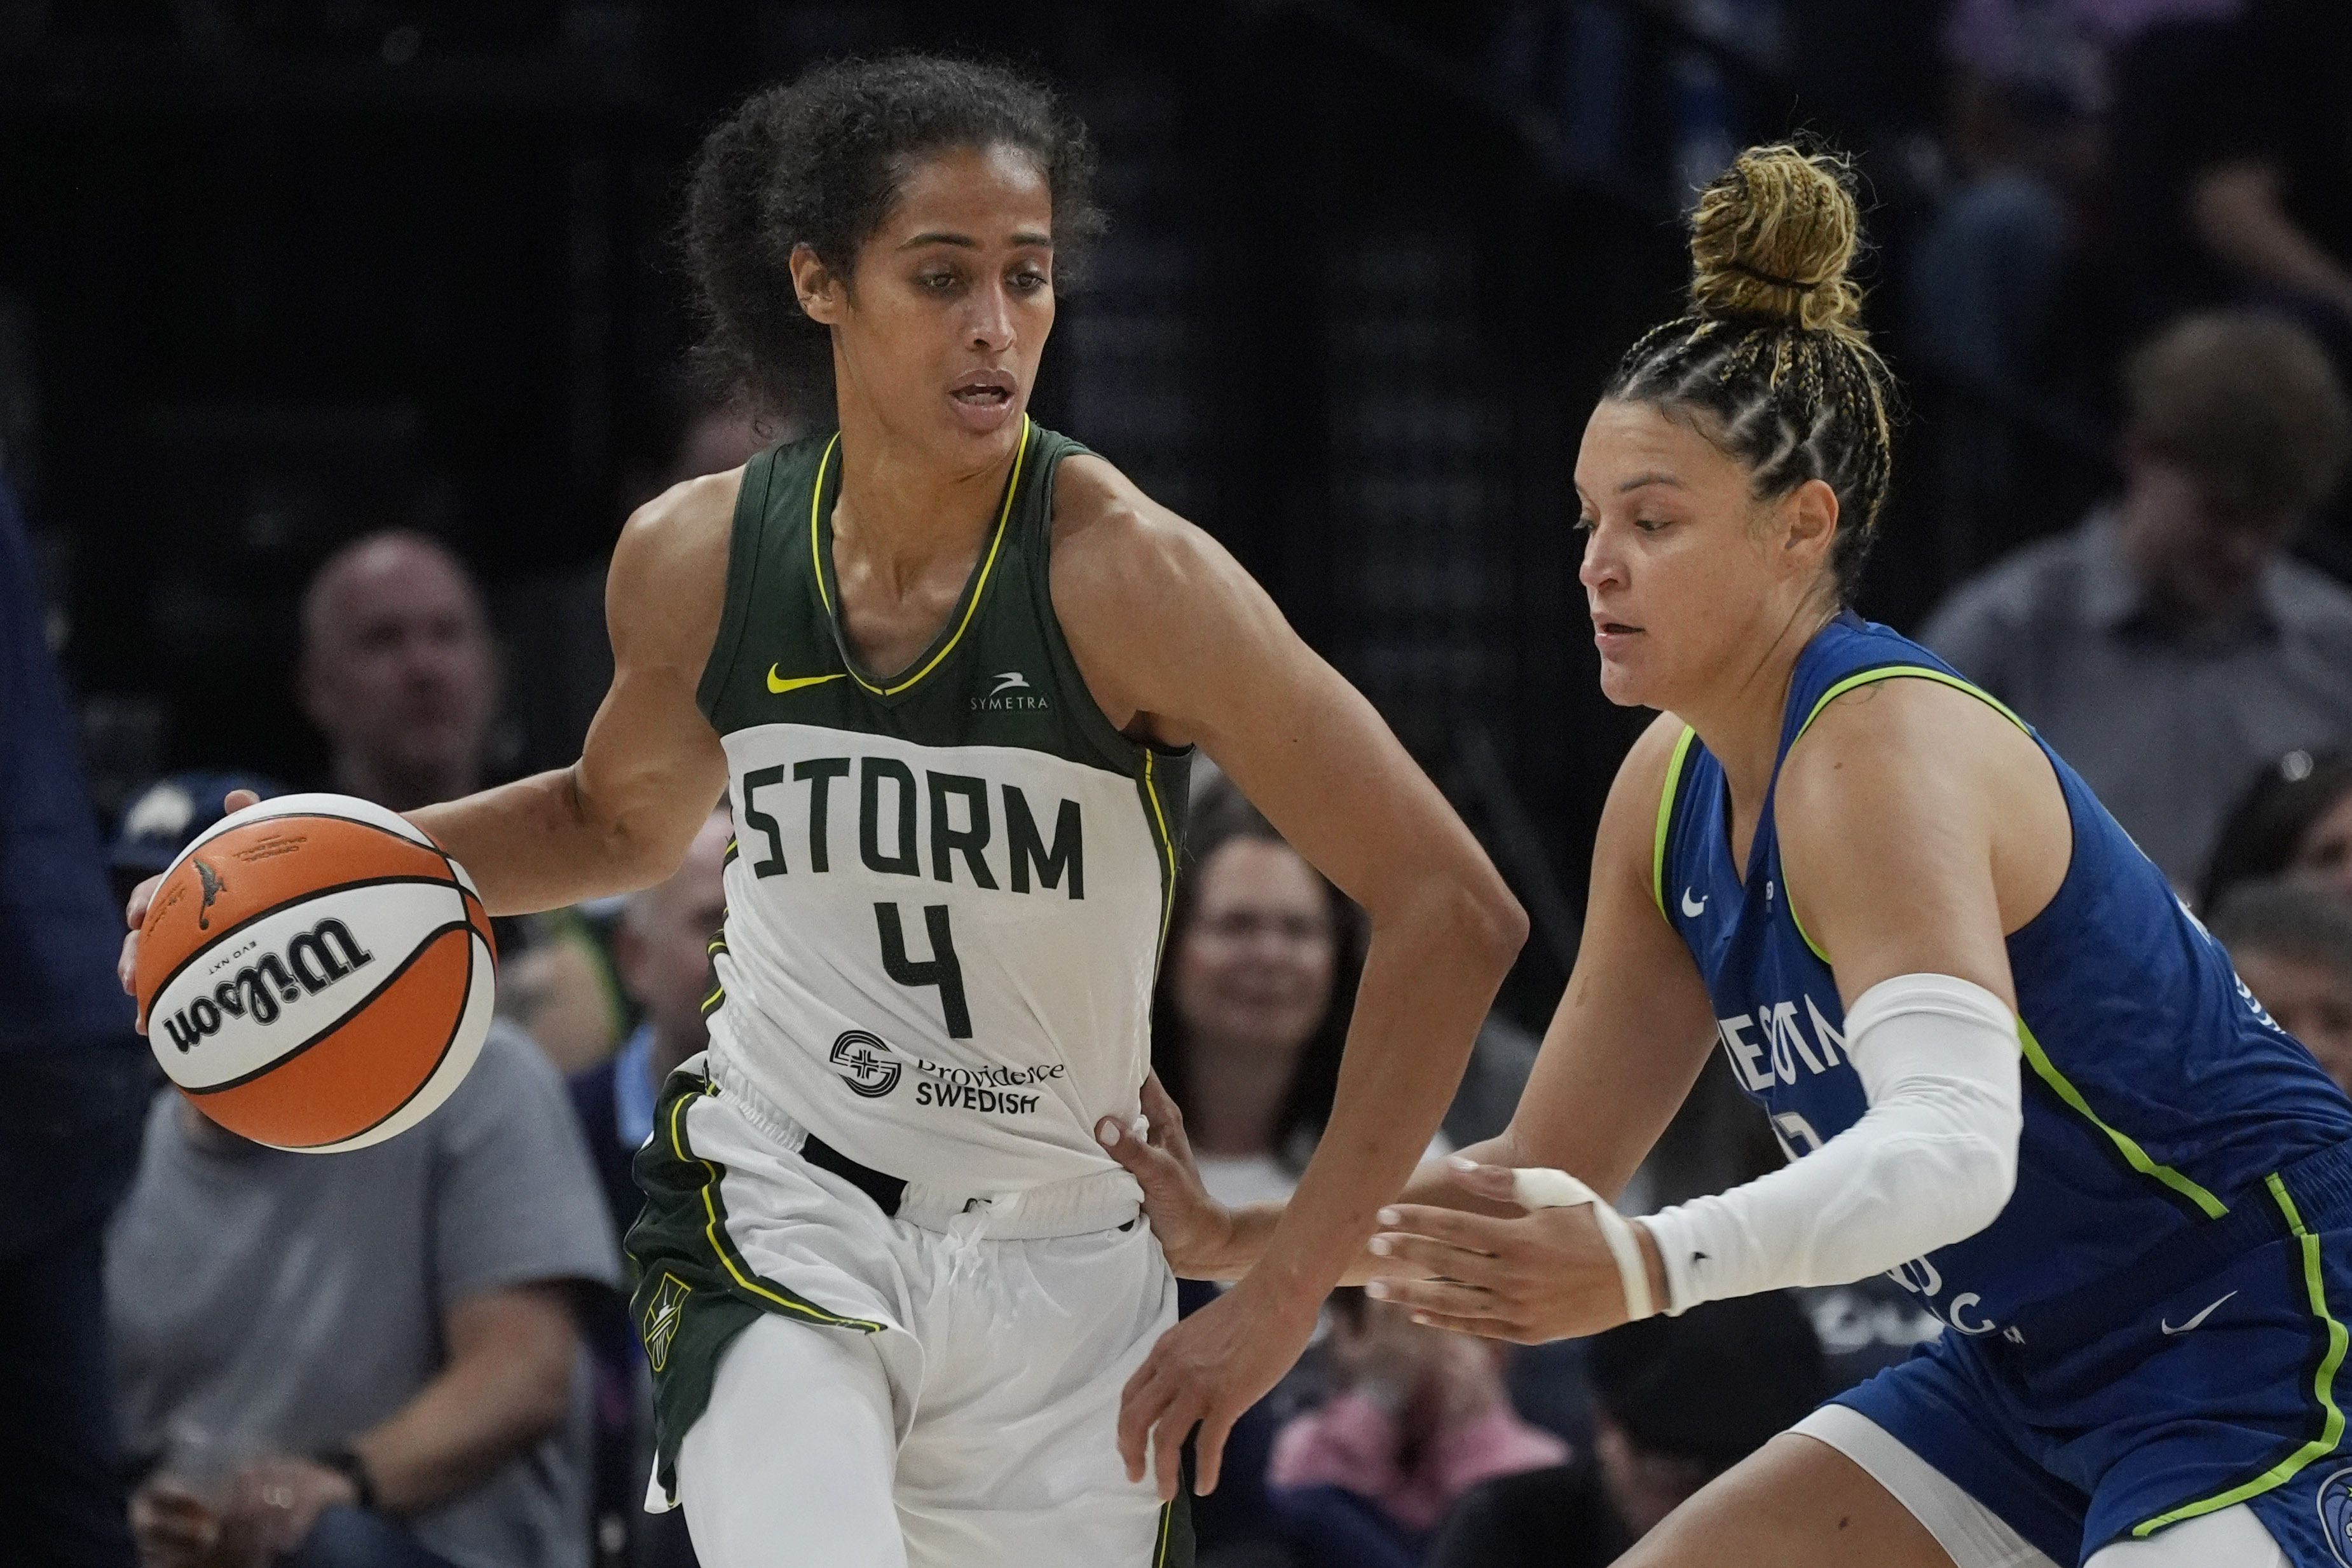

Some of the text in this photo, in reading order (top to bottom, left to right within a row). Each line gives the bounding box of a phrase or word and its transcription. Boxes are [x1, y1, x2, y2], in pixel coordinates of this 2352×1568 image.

[970, 697, 1049, 711] SYMETRA
[743, 756, 1084, 900] STORM
[162, 917, 375, 1055] Wilson
[209, 941, 256, 976] EVO NXT
[873, 902, 974, 1039] 4
[1717, 993, 1849, 1092] ESOTA
[915, 1082, 1040, 1114] SWEDISH
